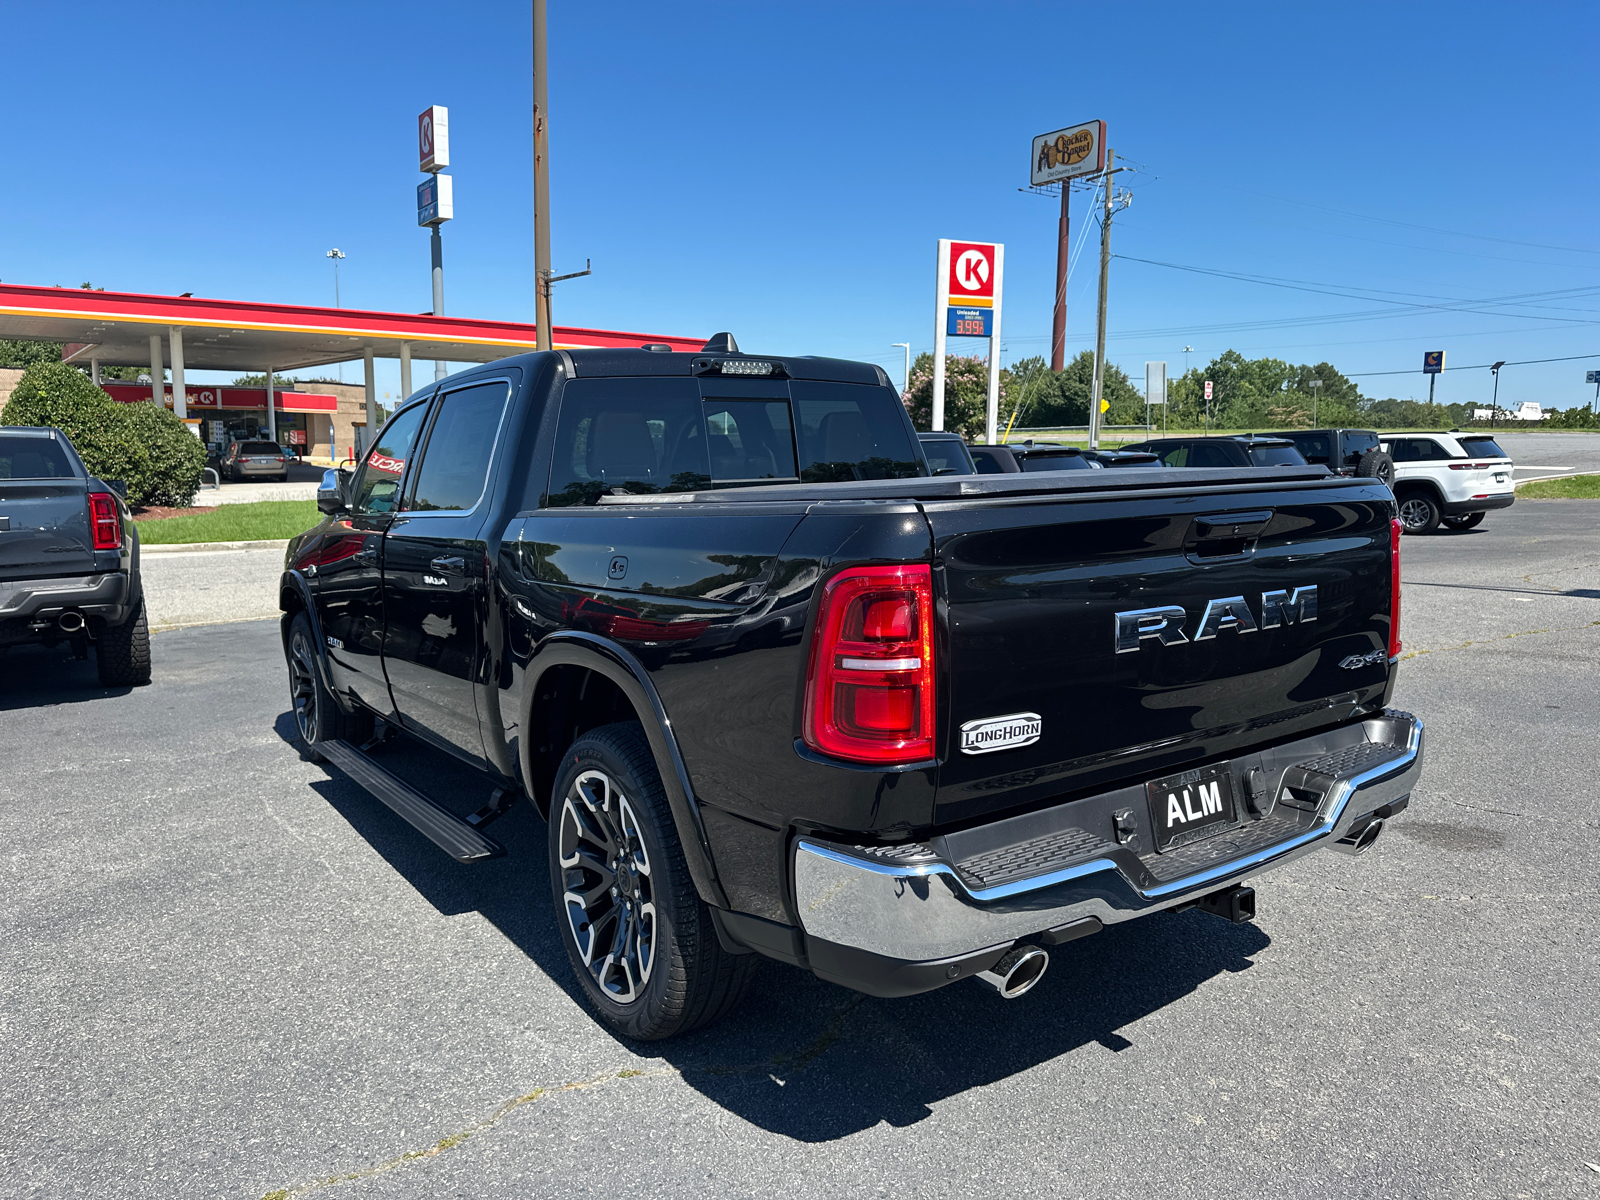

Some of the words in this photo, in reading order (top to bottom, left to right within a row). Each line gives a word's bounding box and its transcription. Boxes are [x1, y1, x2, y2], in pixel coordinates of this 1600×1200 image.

[1061, 142, 1090, 164] Barrel
[1055, 168, 1070, 177] Country
[1114, 584, 1318, 655] RAM
[1167, 781, 1223, 828] ALM
